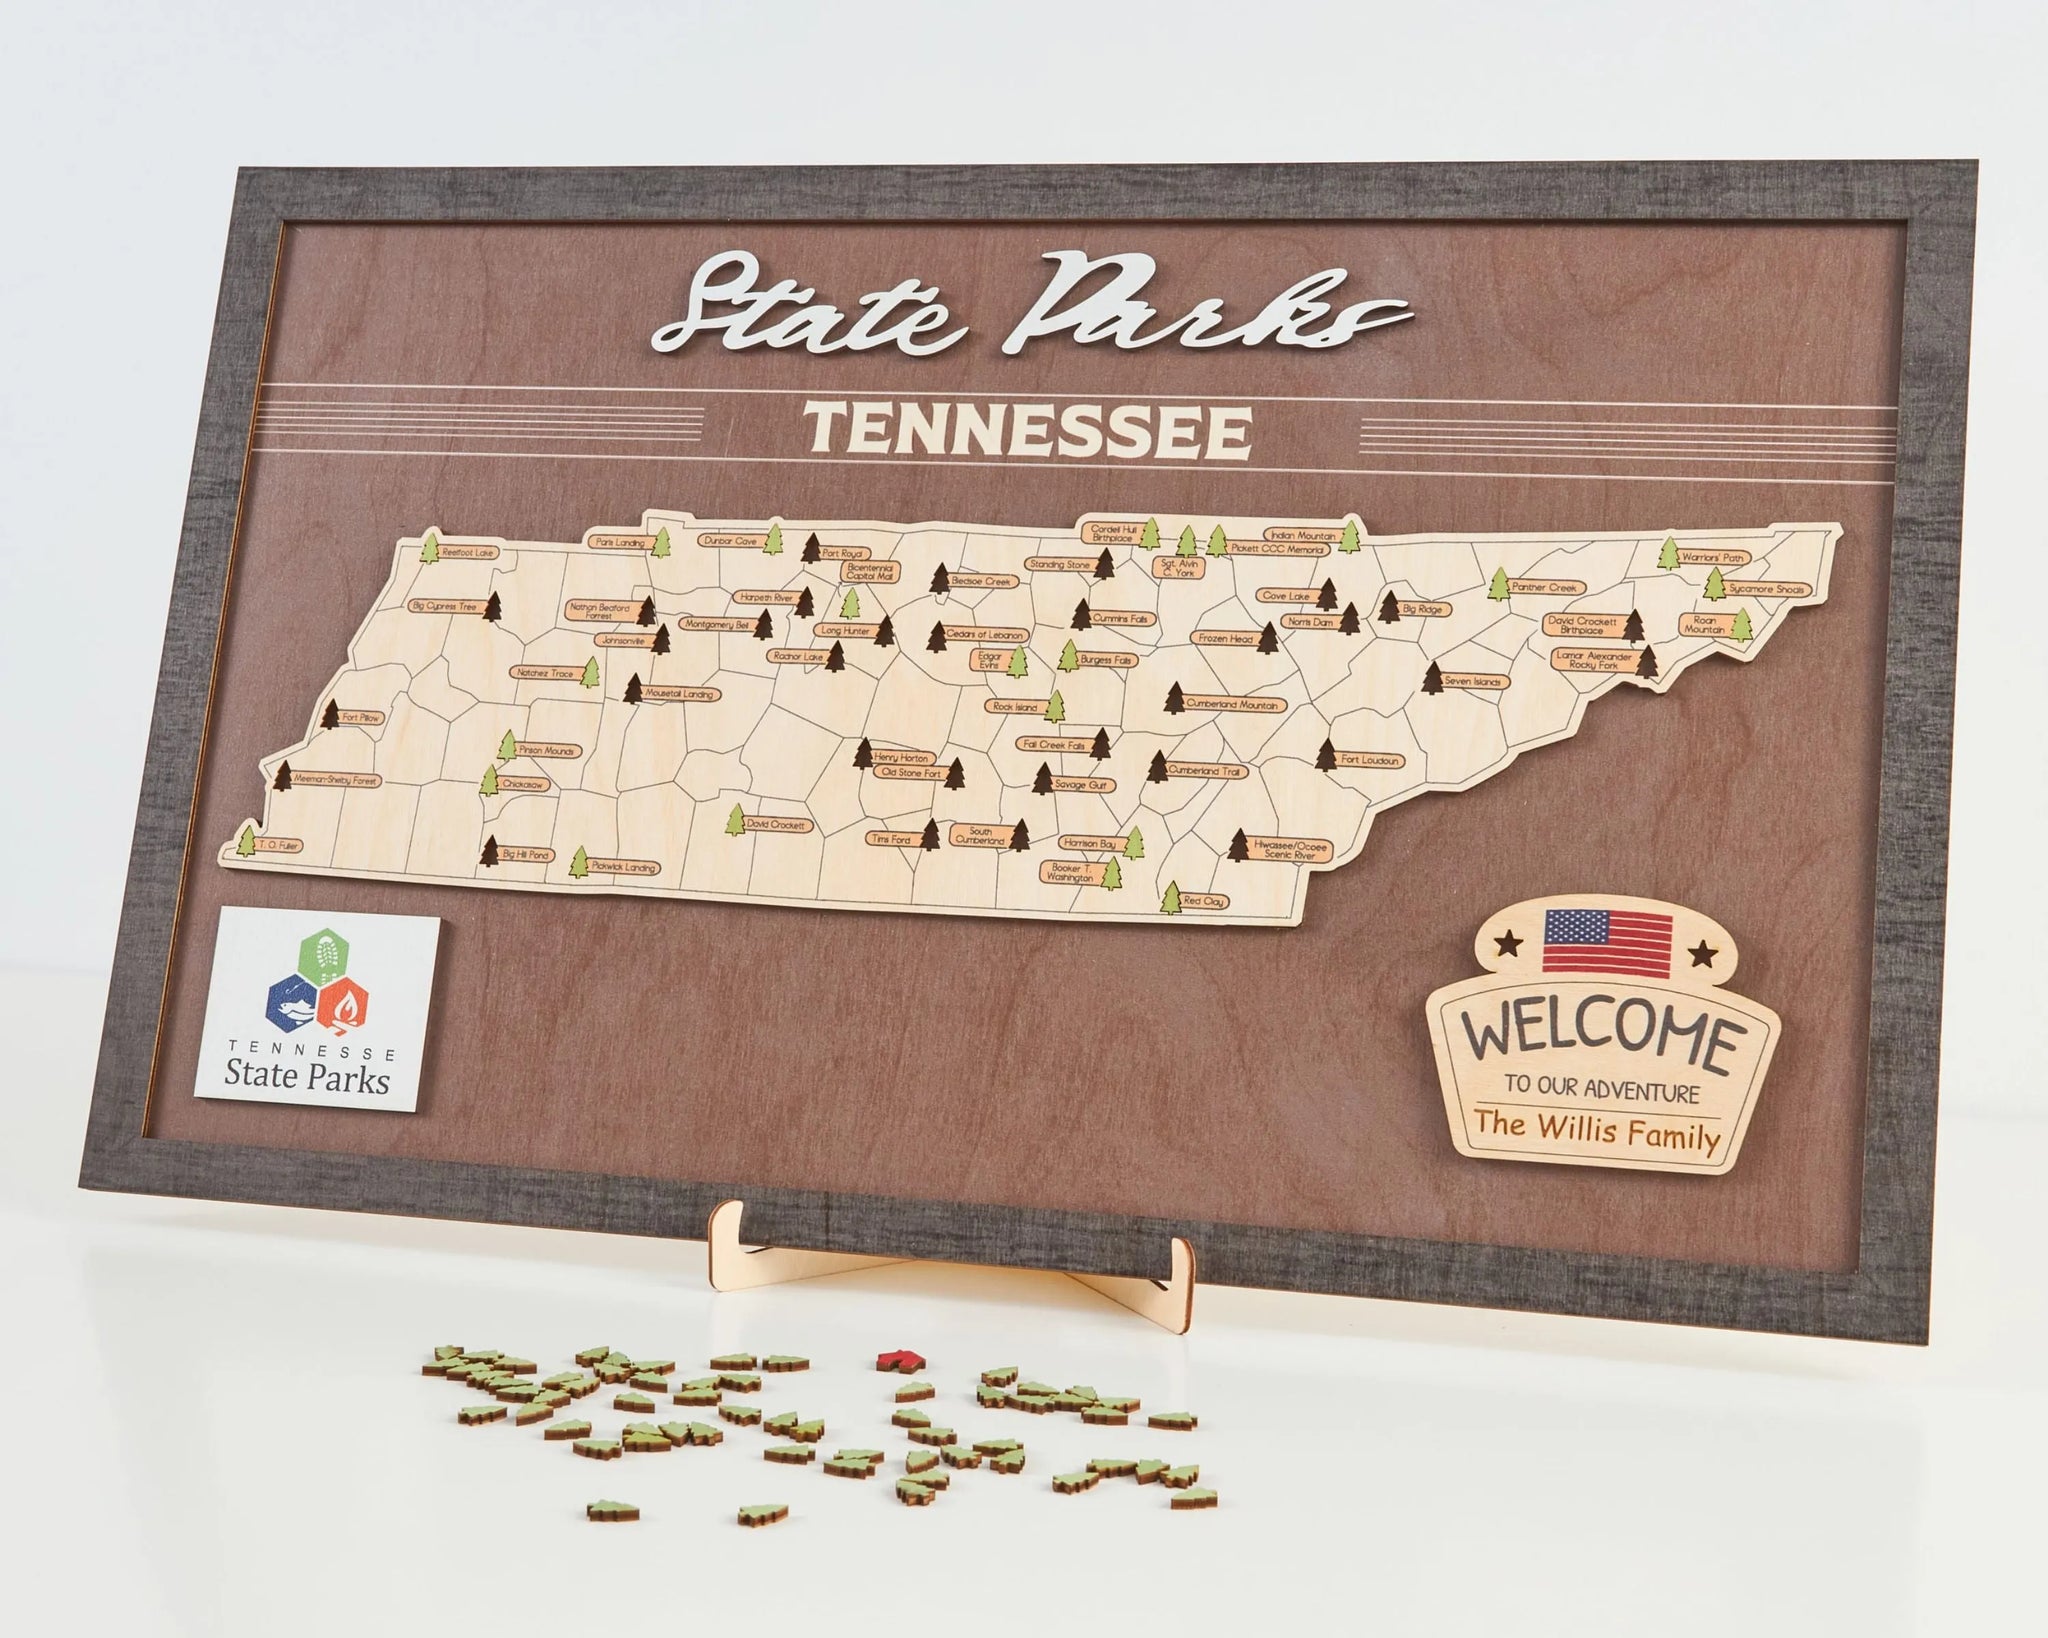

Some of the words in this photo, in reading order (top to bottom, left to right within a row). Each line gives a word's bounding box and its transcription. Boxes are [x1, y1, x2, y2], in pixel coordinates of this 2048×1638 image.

[650, 248, 969, 358] State
[1000, 249, 1415, 356] Parks
[803, 401, 1253, 462] TENNESSEE
[1091, 525, 1119, 533] Cordell
[1093, 533, 1132, 542] Birthplace
[1271, 530, 1296, 539] Indian
[1298, 531, 1336, 540] Mountain
[596, 538, 613, 546] Paris
[616, 538, 645, 548] Landing
[705, 537, 732, 545] Dunbar
[823, 549, 838, 557] Port
[842, 550, 863, 559] Royal
[1231, 544, 1258, 552] Pickett
[1262, 545, 1283, 553] CCC
[1285, 546, 1324, 554] Memorial
[1161, 559, 1177, 568] Sgt.
[1723, 554, 1744, 563] Path
[848, 563, 893, 572] Bicentennial
[1030, 560, 1064, 570] Standing
[1068, 561, 1090, 569] Stone
[847, 571, 874, 582] Capitol
[1163, 567, 1173, 575] C.
[1176, 568, 1194, 577] York
[985, 578, 1010, 586] Creek
[1512, 582, 1545, 592] Panther
[1549, 584, 1577, 592] Creek
[1730, 584, 1773, 595] Sycamore
[1776, 585, 1804, 594] Shoals
[741, 593, 772, 603] Harpeth
[775, 594, 792, 602] River
[1263, 591, 1286, 601] Cove
[1289, 592, 1310, 601] Lake
[413, 603, 427, 611] Big
[428, 603, 456, 612] Cypress
[460, 603, 477, 611] Tree
[570, 603, 596, 611] Nathan
[1404, 604, 1417, 614] Big
[1419, 605, 1442, 615] Ridge
[585, 611, 612, 619] Forrest
[1093, 614, 1128, 623] Cummins
[1131, 615, 1147, 623] Falls
[685, 620, 733, 630] Montgomery
[1289, 617, 1310, 626] Norris
[1313, 618, 1333, 627] Dam
[1548, 616, 1578, 626] David
[1579, 617, 1616, 626] Crockett
[1694, 616, 1716, 625] Roan
[822, 626, 841, 636] Long
[844, 627, 869, 635] Hunter
[947, 629, 973, 638] Cedars
[975, 630, 986, 638] of
[989, 631, 1023, 639] Lebanon
[1560, 626, 1603, 636] Birthplace
[1685, 625, 1725, 634] Mountain
[602, 636, 645, 645] Johnsonville
[1199, 634, 1228, 642] Frozen
[1231, 635, 1253, 643] Head
[775, 652, 800, 660] Radnor
[804, 652, 823, 661] Lake
[978, 652, 1001, 661] Edgar
[1081, 655, 1111, 665] Burgess
[1114, 656, 1131, 664] Falls
[1556, 652, 1584, 661] Lamar
[1587, 652, 1632, 662] Alexander
[980, 661, 999, 669] Evins
[1570, 660, 1595, 670] Rocky
[1599, 661, 1618, 670] Fork
[517, 668, 548, 676] Natchez
[551, 669, 573, 677] Trace
[1445, 676, 1471, 685] Seven
[1473, 677, 1501, 686] Islands
[646, 688, 680, 698] Mousetail
[683, 690, 713, 700] Landing
[994, 702, 1013, 711] Rock
[1015, 703, 1037, 712] Island
[1187, 698, 1236, 708] Cumberland
[1239, 700, 1278, 710] Mountain
[342, 713, 359, 721] Fort
[361, 714, 380, 722] Pillow
[1023, 740, 1036, 748] Fall
[1040, 741, 1064, 749] Creek
[1068, 742, 1084, 750] Falls
[519, 745, 543, 754] Pinson
[546, 746, 574, 756] Mounds
[875, 752, 898, 762] Henry
[901, 754, 928, 762] Horton
[1341, 754, 1360, 764] Fort
[1364, 756, 1399, 765] Loudoun
[882, 768, 896, 776] Old
[899, 769, 921, 777] Stone
[1168, 765, 1218, 775] Cumberland
[1220, 767, 1240, 776] Trail
[294, 774, 351, 785] Meeman-Shelby
[353, 777, 376, 785] Forest
[503, 779, 542, 789] Chickasaw
[1055, 780, 1086, 790] Savage
[1089, 781, 1107, 790] Gulf
[747, 820, 769, 828] David
[771, 821, 805, 830] Crockett
[970, 827, 992, 836] South
[872, 835, 889, 843] Tims
[892, 836, 910, 844] Ford
[955, 835, 1004, 845] Cumberland
[1064, 838, 1095, 848] Harrison
[1097, 839, 1116, 849] Bay
[280, 842, 298, 850] Fuller
[503, 850, 516, 859] Big
[518, 851, 528, 859] Hill
[530, 851, 549, 860] Pond
[1264, 849, 1294, 859] Scenic
[1296, 851, 1315, 860] River
[592, 861, 623, 871] Pickwick
[625, 863, 655, 873] Landing
[1052, 864, 1082, 873] Booker
[1085, 865, 1092, 873] T.
[1047, 872, 1093, 883] Washington
[1184, 896, 1204, 905] Red
[1205, 897, 1224, 907] Clay
[1461, 994, 1748, 1077] WELCOME
[229, 1039, 394, 1061] TENNESSE
[224, 1058, 298, 1088] State
[307, 1063, 390, 1094] Parks
[1505, 1073, 1530, 1092] TO
[1538, 1077, 1578, 1095] OUR
[1585, 1080, 1701, 1104] ADVENTURE
[1474, 1109, 1525, 1136] The
[1538, 1113, 1617, 1143] Willis
[1628, 1120, 1721, 1158] Family
